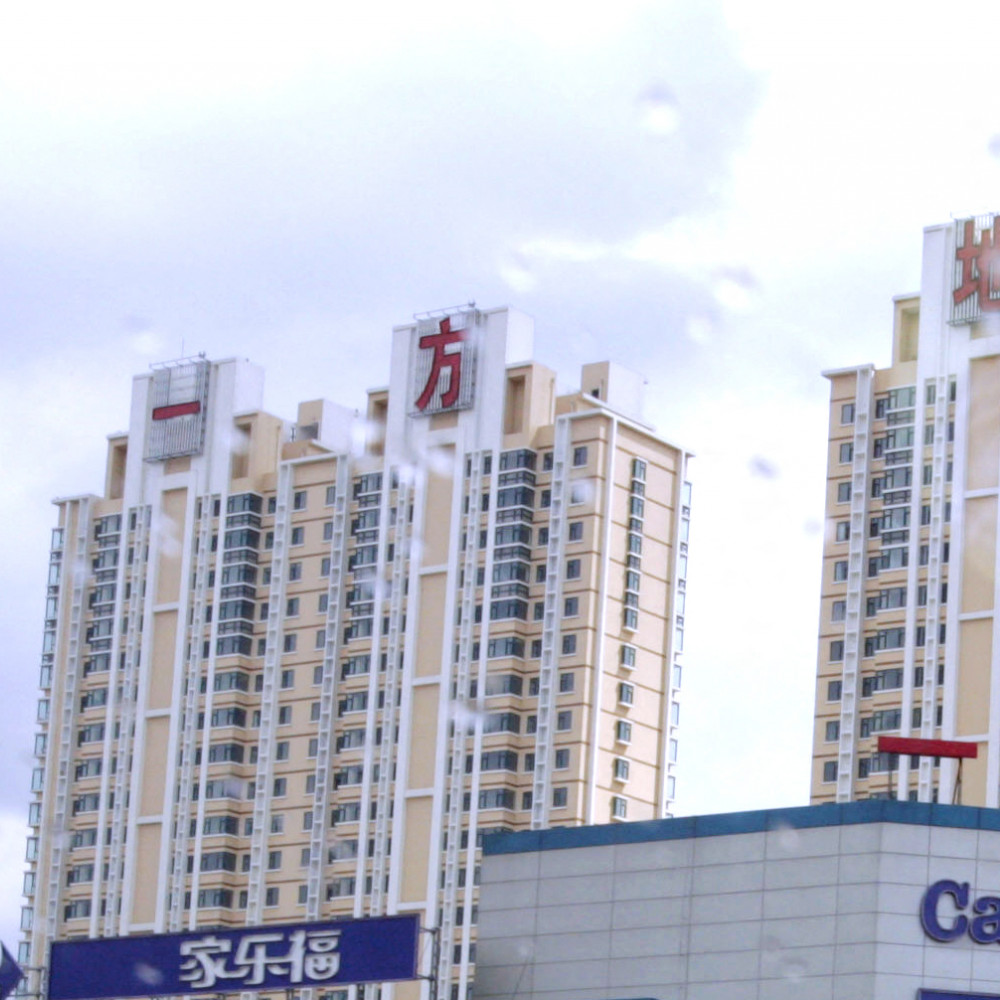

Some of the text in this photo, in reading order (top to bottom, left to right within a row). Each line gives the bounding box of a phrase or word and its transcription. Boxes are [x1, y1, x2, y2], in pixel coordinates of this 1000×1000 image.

[415, 317, 471, 411] 方
[178, 929, 342, 989] 家乐福
